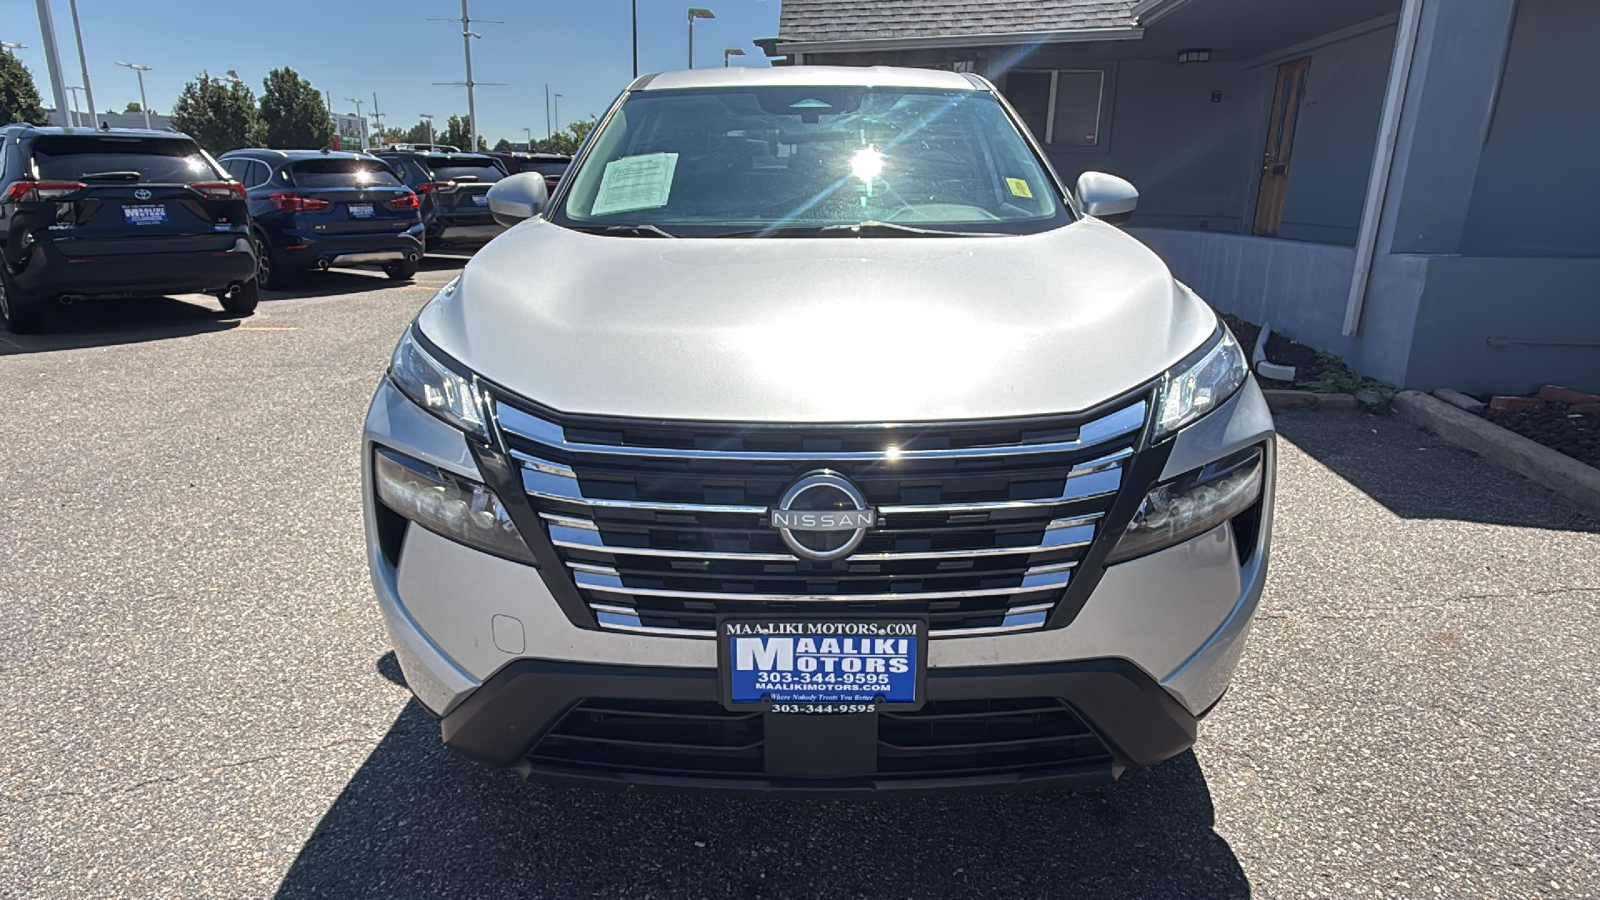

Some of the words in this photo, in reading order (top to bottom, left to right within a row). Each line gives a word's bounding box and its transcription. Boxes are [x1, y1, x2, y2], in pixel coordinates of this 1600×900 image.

[774, 512, 872, 527] NISSAN
[757, 672, 889, 683] 303-344-9595
[755, 683, 891, 691] MAALIKIMOTORS.COM
[770, 693, 791, 701] Where
[792, 694, 817, 703] Nobody
[771, 704, 875, 713] 303-344-9595
